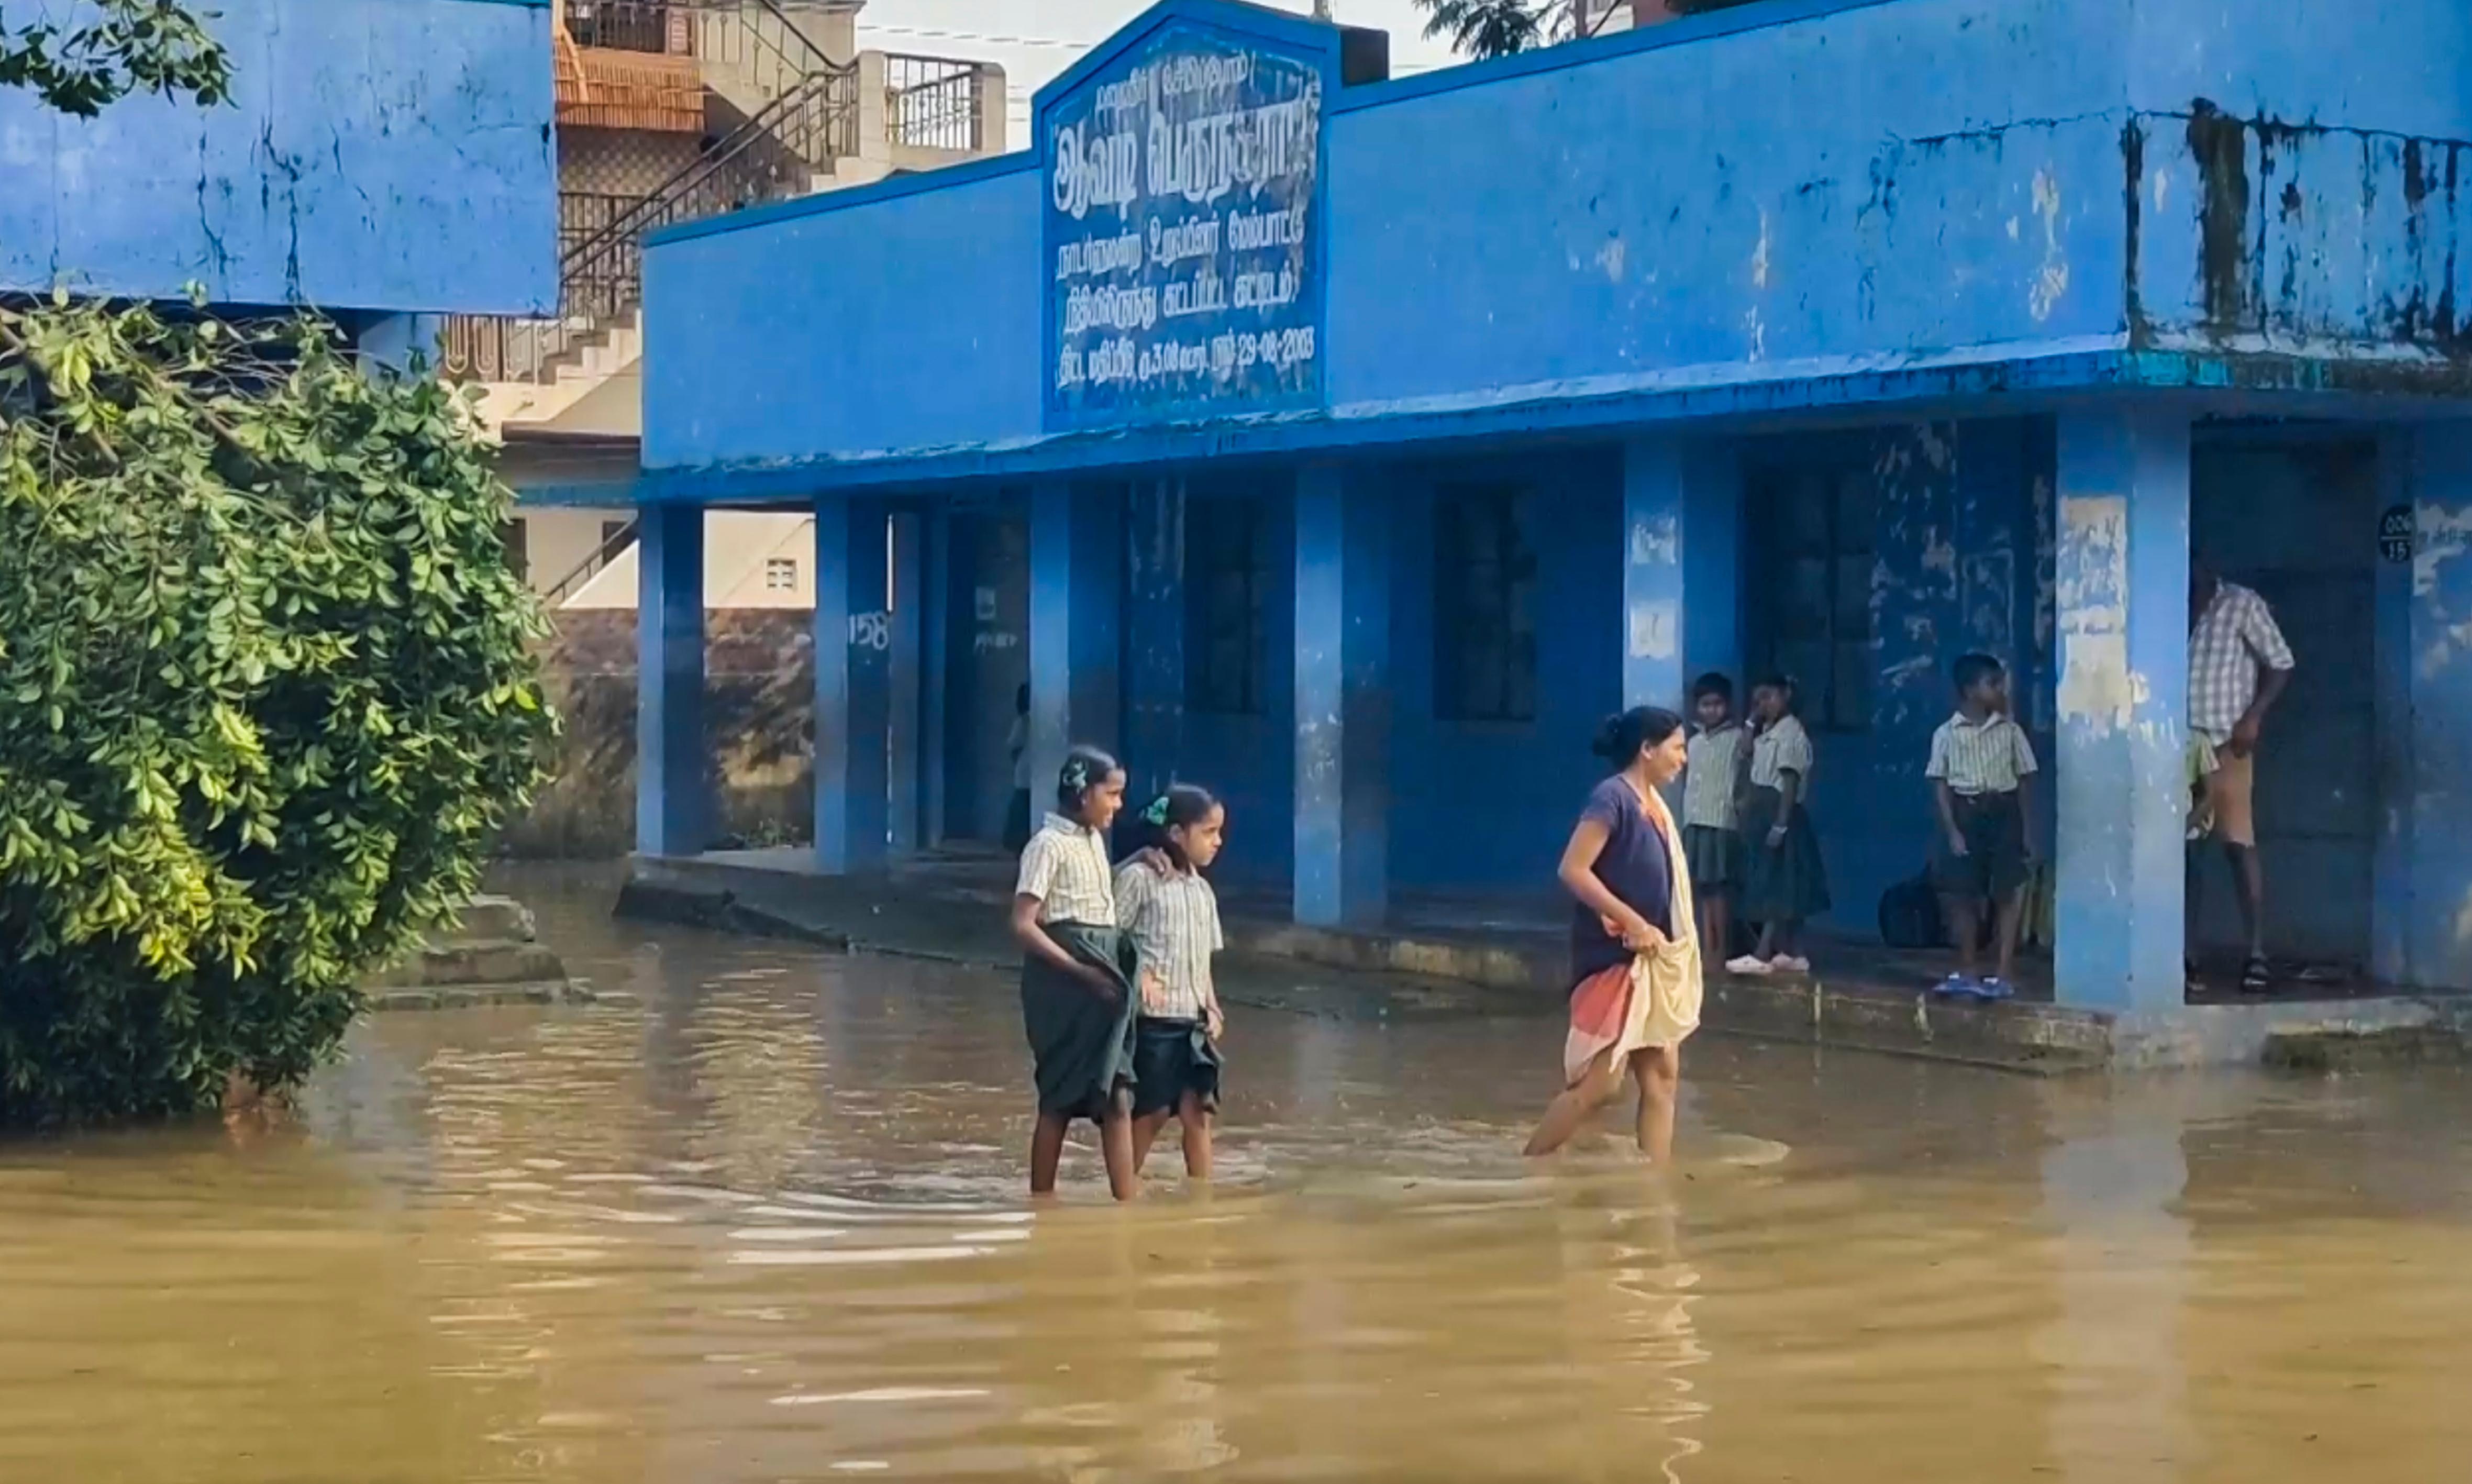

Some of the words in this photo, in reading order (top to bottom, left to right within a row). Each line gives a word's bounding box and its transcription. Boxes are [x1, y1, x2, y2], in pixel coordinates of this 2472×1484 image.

[1053, 117, 1138, 222] ஆவடி
[1150, 214, 1219, 267] உறுப்பினர்
[848, 612, 888, 650] 158
